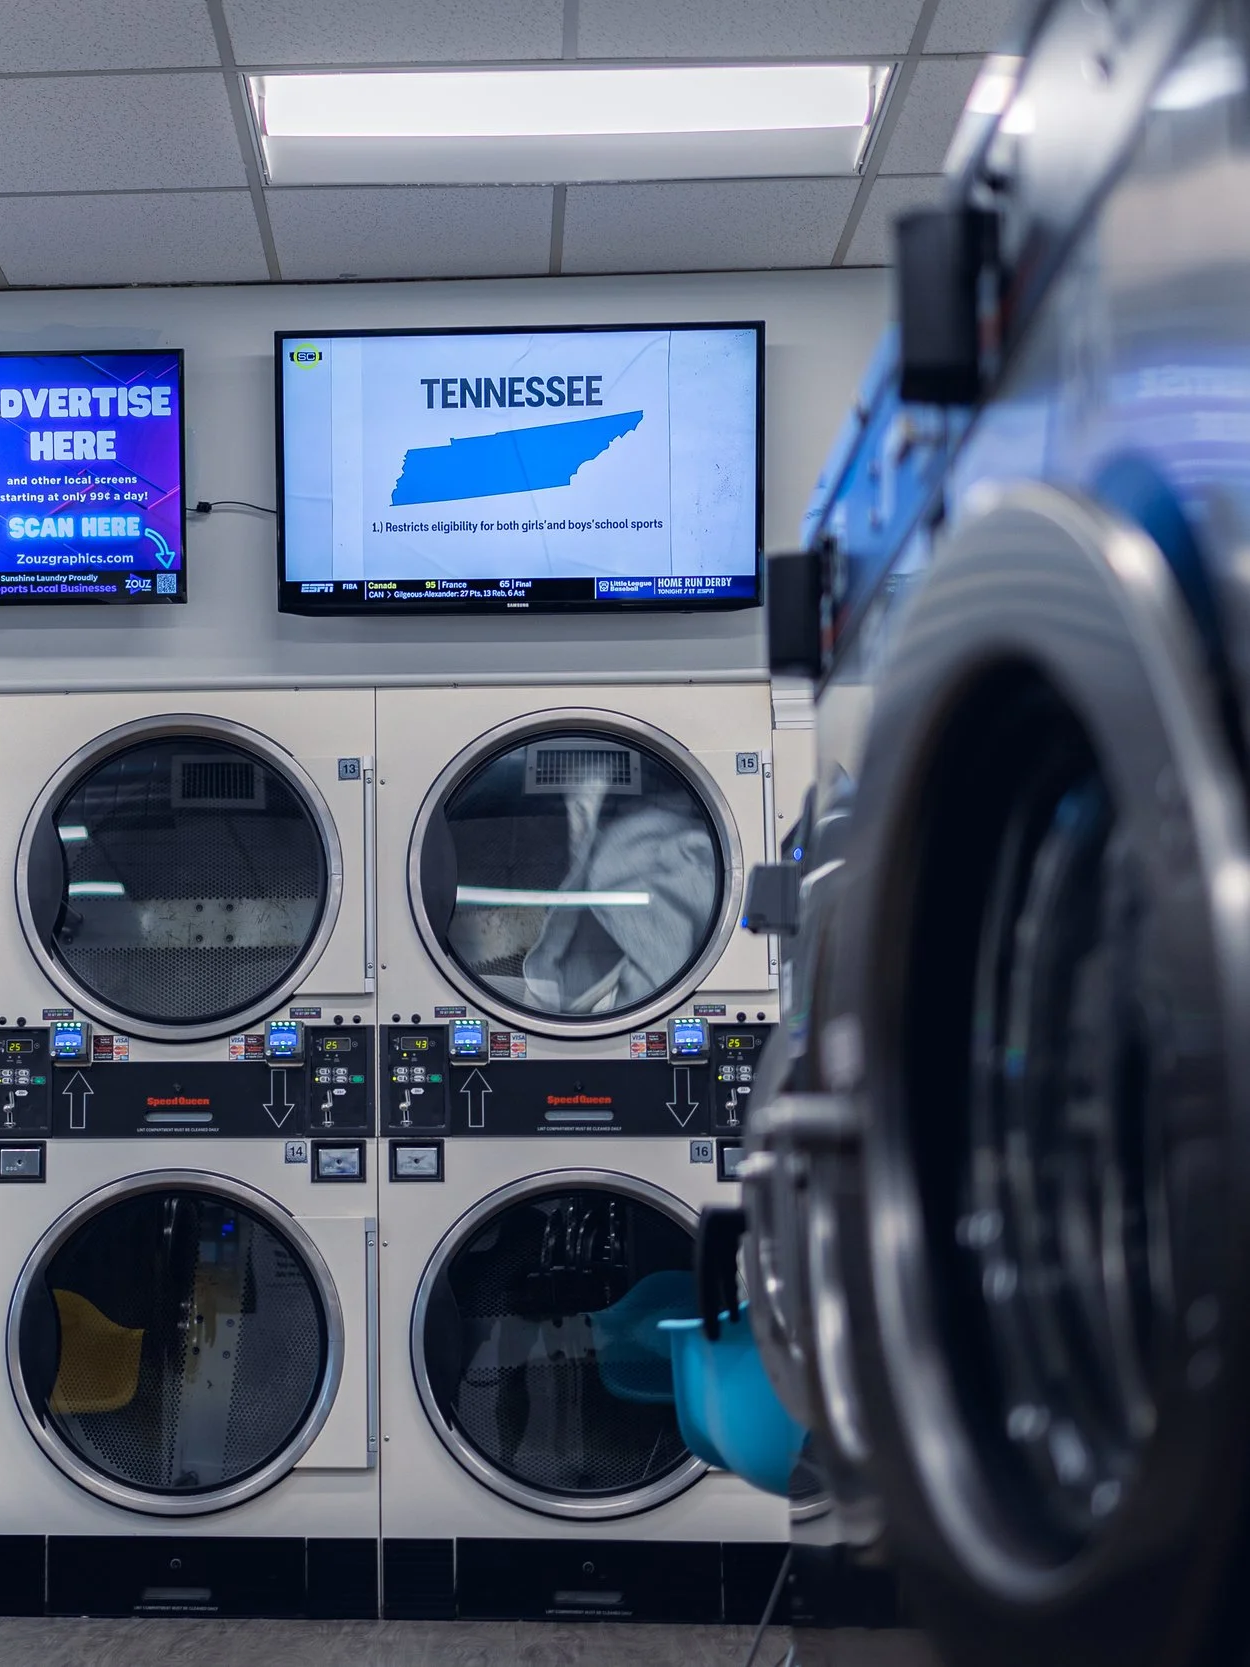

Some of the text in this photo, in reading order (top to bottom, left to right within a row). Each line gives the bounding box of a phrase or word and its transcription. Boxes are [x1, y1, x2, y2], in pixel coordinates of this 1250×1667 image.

[297, 352, 316, 361] SC
[420, 375, 603, 409] TENNESSEE
[30, 430, 117, 461] HERE
[7, 475, 137, 485] and other local screens
[0, 491, 148, 503] starting at only 99¢ a day!
[8, 516, 141, 539] SCAN HERE
[372, 521, 383, 534] 1.)
[385, 521, 429, 533] Restricts
[431, 521, 478, 534] eligibility
[480, 520, 494, 532] for
[496, 520, 520, 531] both
[630, 519, 663, 532] sports
[16, 553, 134, 566] Zouzgraphics.com
[0, 574, 98, 583] Sunshine Laundry Proudly
[657, 577, 732, 588] HOME RUN DERBY
[30, 584, 59, 593] Local
[60, 583, 117, 593] Businesses
[125, 579, 151, 589] ZOUZ
[301, 583, 334, 593] ESPN
[368, 580, 532, 590] Canada 95 France 65 Final
[394, 590, 459, 599] Gilgeous-Alexander:
[470, 590, 483, 598] Pts,
[741, 758, 754, 768] 15
[343, 764, 355, 774] 13
[9, 1043, 21, 1051] 25
[326, 1041, 338, 1050] 25
[415, 1040, 428, 1049] 43
[728, 1039, 740, 1048] 25
[290, 1146, 303, 1156] 14
[695, 1146, 709, 1157] 16
